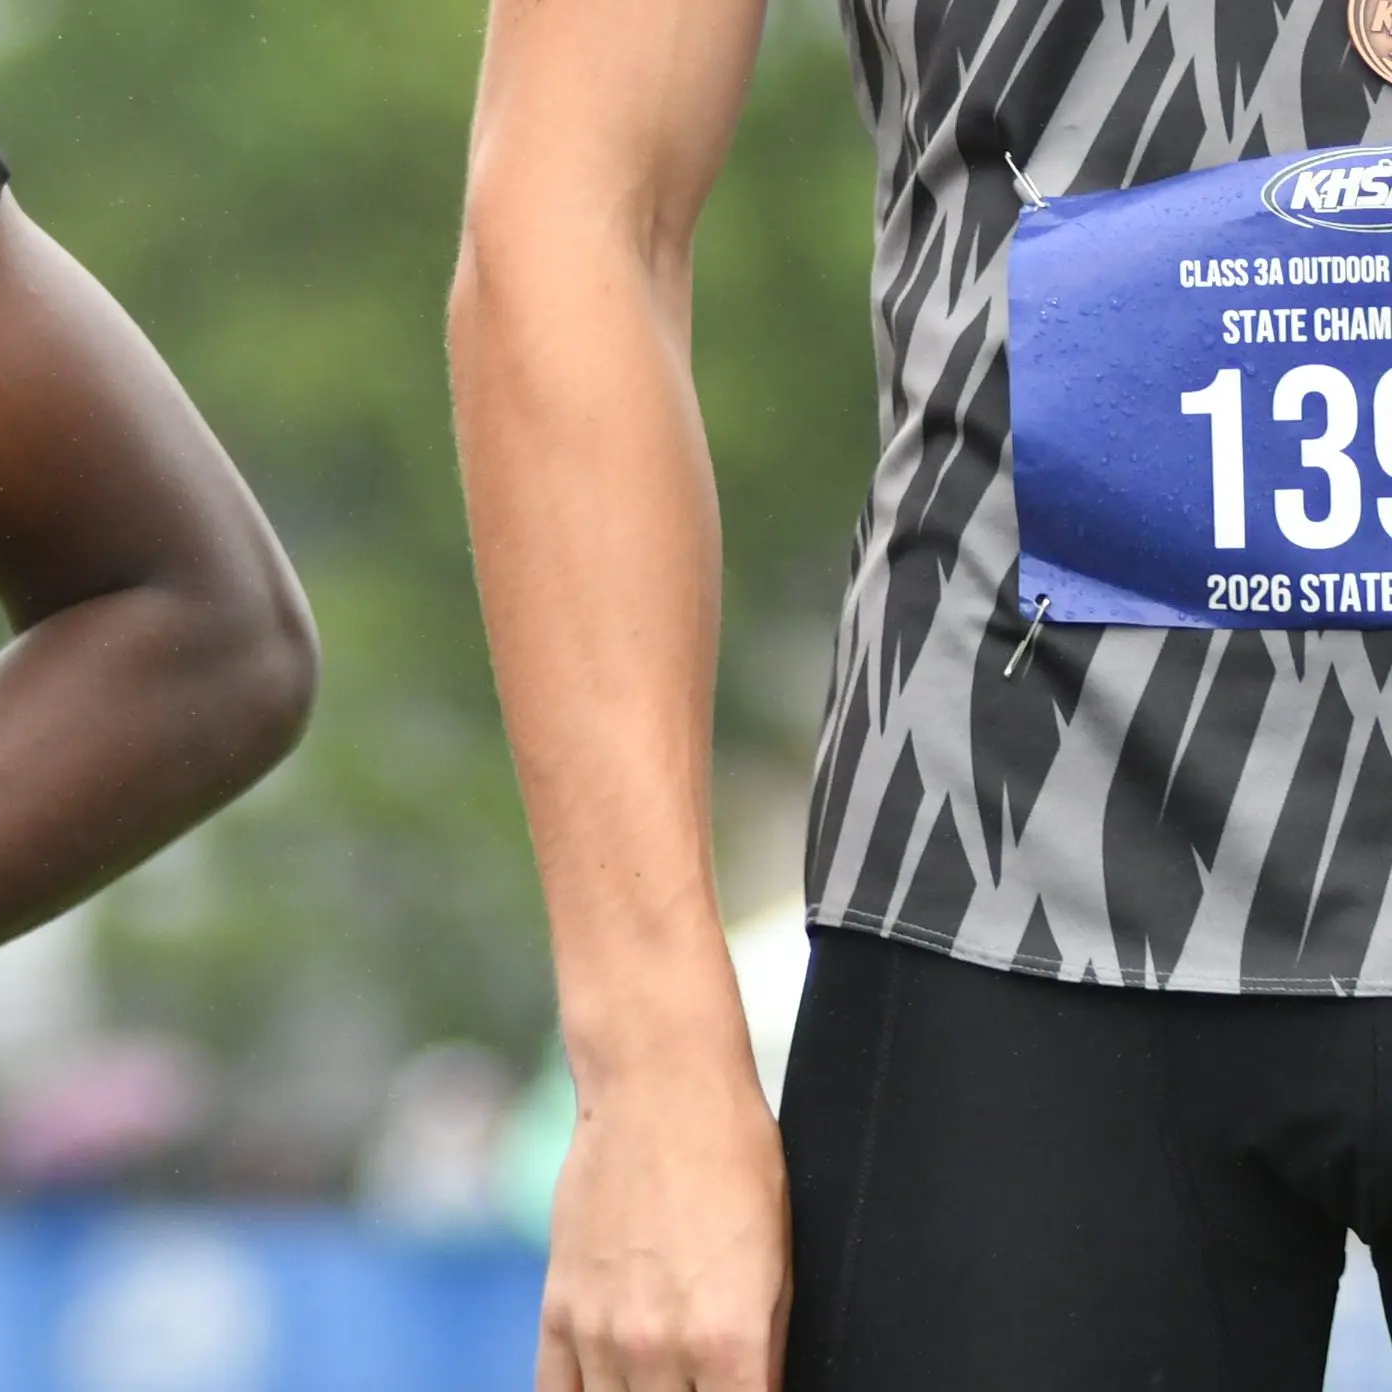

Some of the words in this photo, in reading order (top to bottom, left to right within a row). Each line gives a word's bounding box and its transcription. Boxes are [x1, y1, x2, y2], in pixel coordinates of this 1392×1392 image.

[1290, 163, 1392, 212] KHS
[1179, 259, 1249, 288] CLASS
[1254, 258, 1284, 286] 3A
[1288, 255, 1391, 285] OUTDOOR
[1222, 308, 1308, 344] STATE
[1181, 364, 1392, 550] 13
[1207, 573, 1292, 612] 2026
